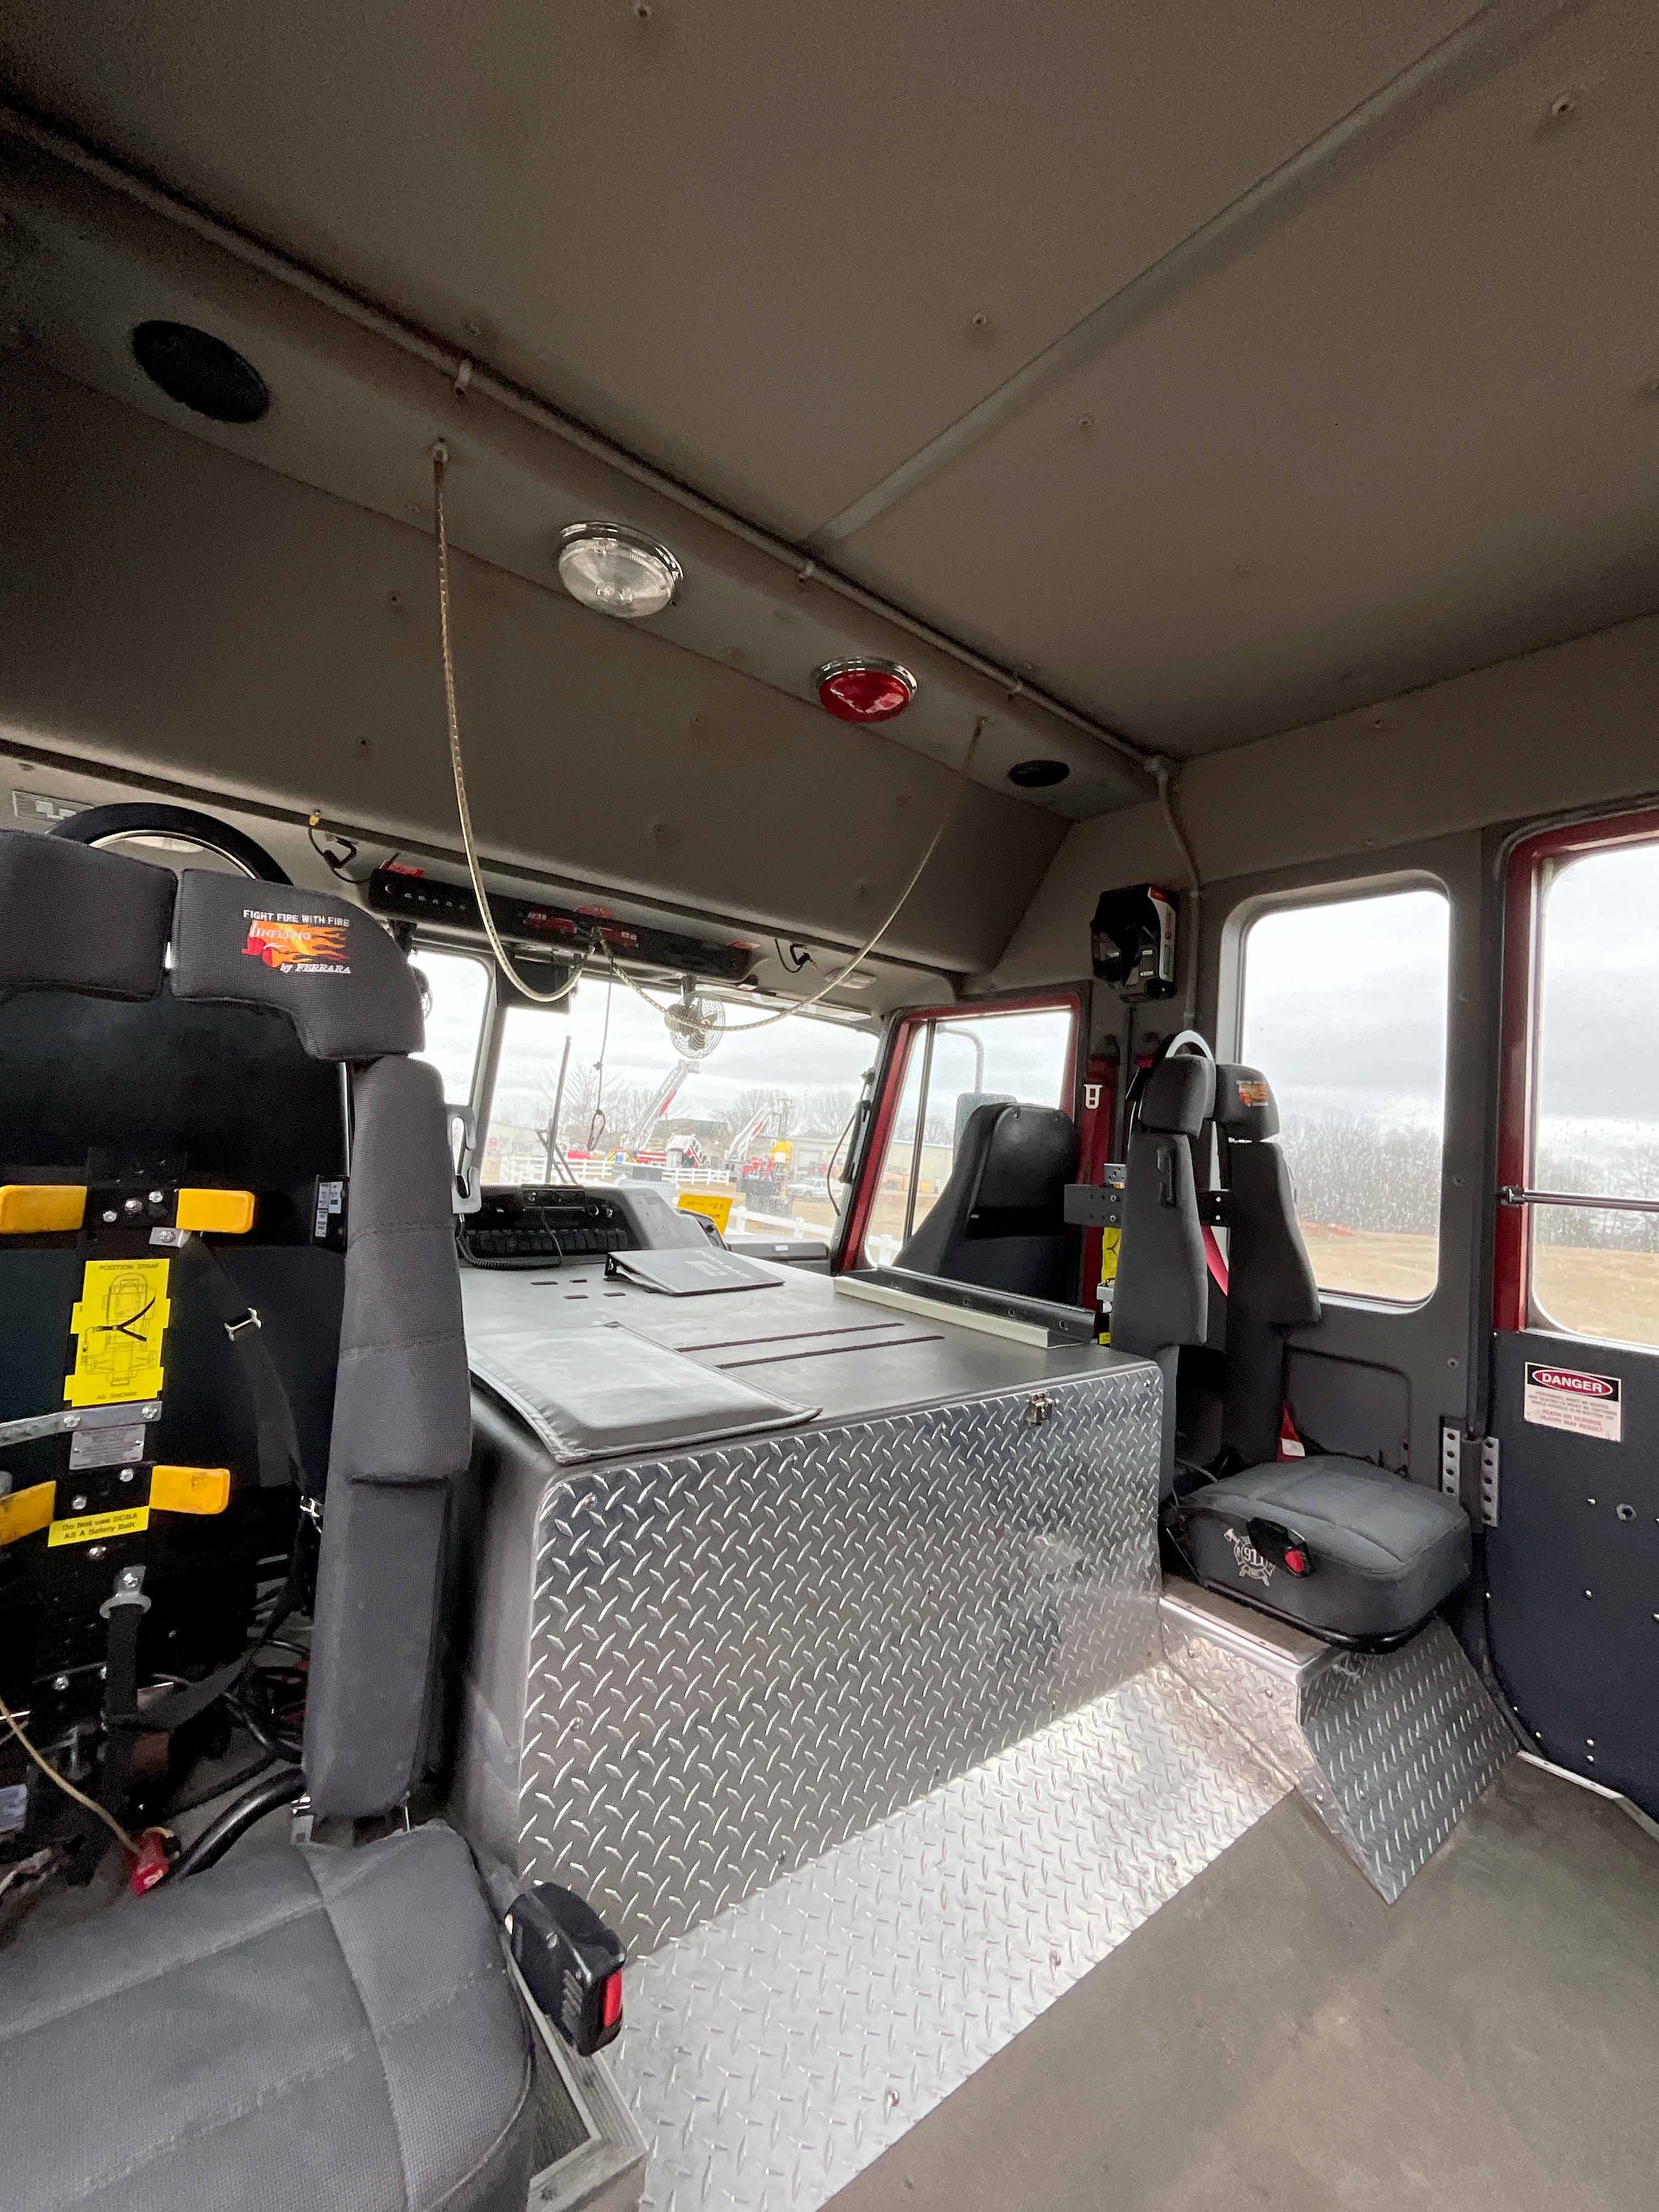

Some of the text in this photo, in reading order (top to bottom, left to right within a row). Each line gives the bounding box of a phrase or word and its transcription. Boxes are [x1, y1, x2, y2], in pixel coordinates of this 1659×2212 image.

[244, 909, 351, 927] FIGHT FIRE WITH FIRE
[280, 962, 351, 974] by FERRARA
[1542, 1373, 1602, 1393] DANGER
[114, 1513, 138, 1522] SCBA
